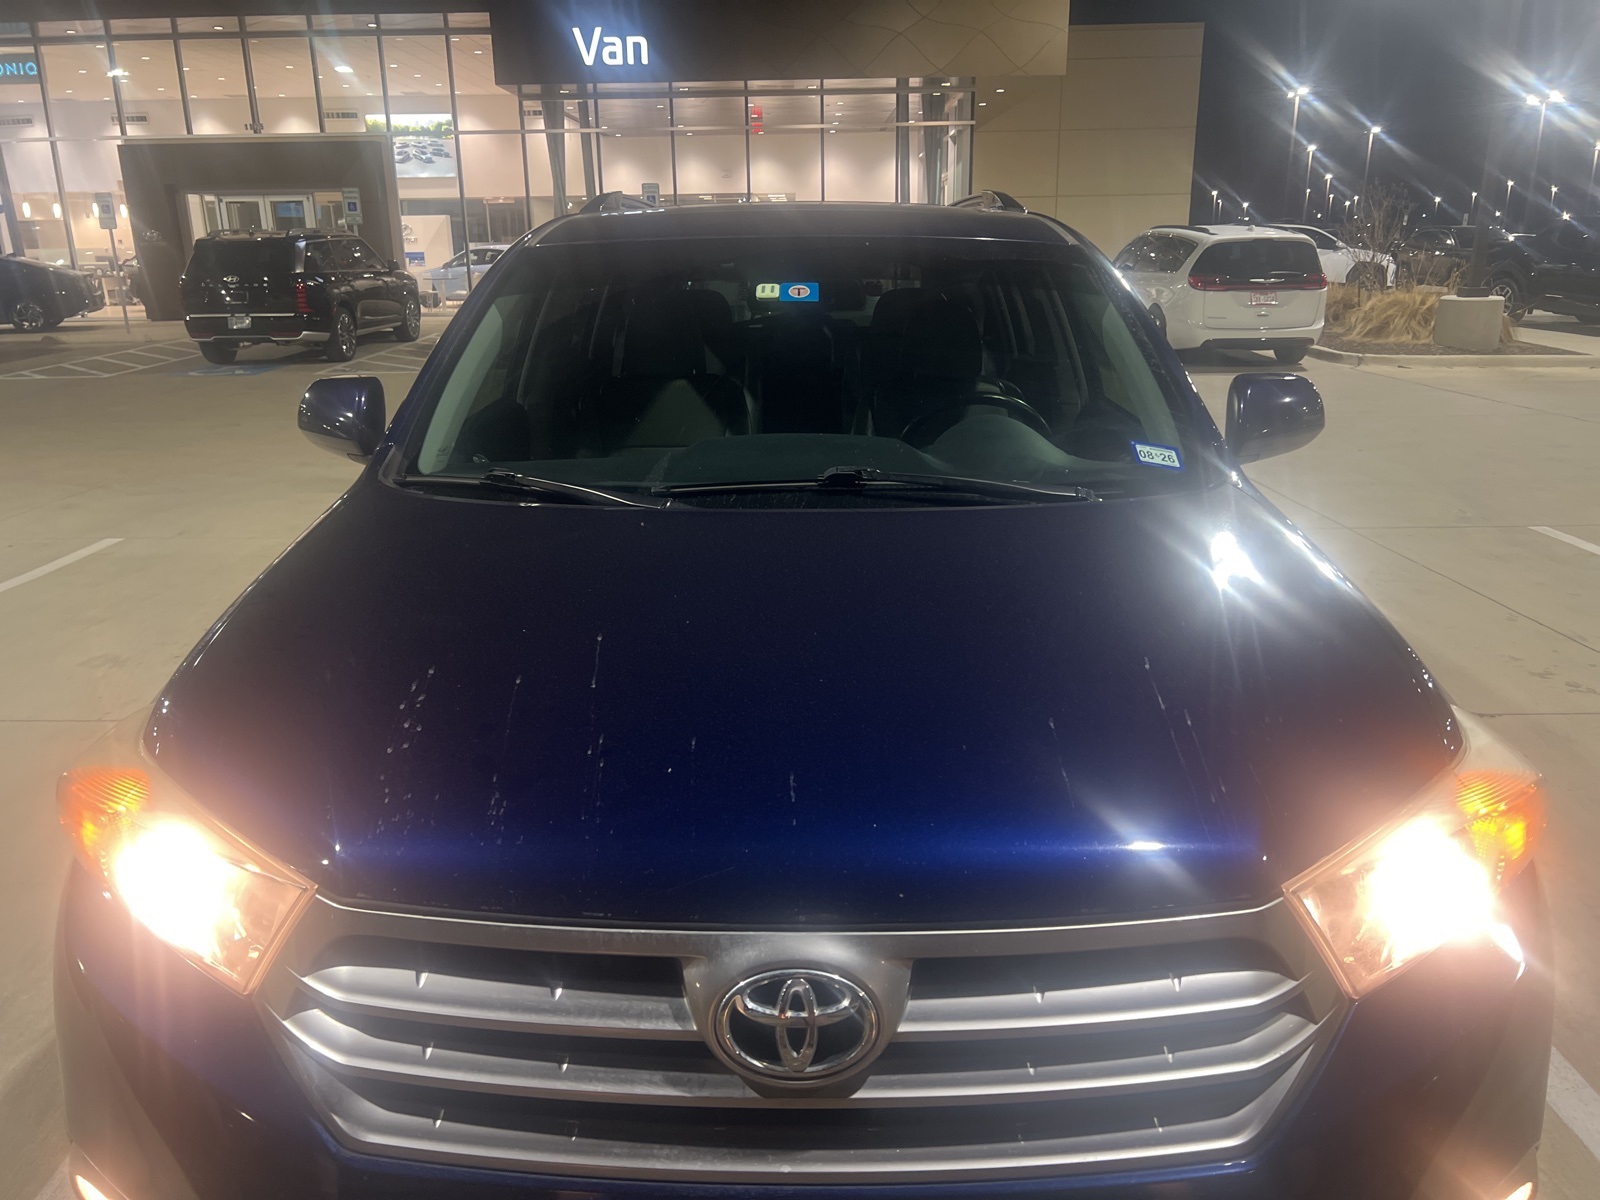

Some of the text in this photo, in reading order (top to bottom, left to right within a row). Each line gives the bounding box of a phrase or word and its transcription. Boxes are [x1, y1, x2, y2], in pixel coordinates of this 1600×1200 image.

[572, 26, 649, 66] Van
[0, 61, 37, 76] NIQ
[1138, 449, 1155, 460] 08
[1159, 453, 1176, 463] 26
